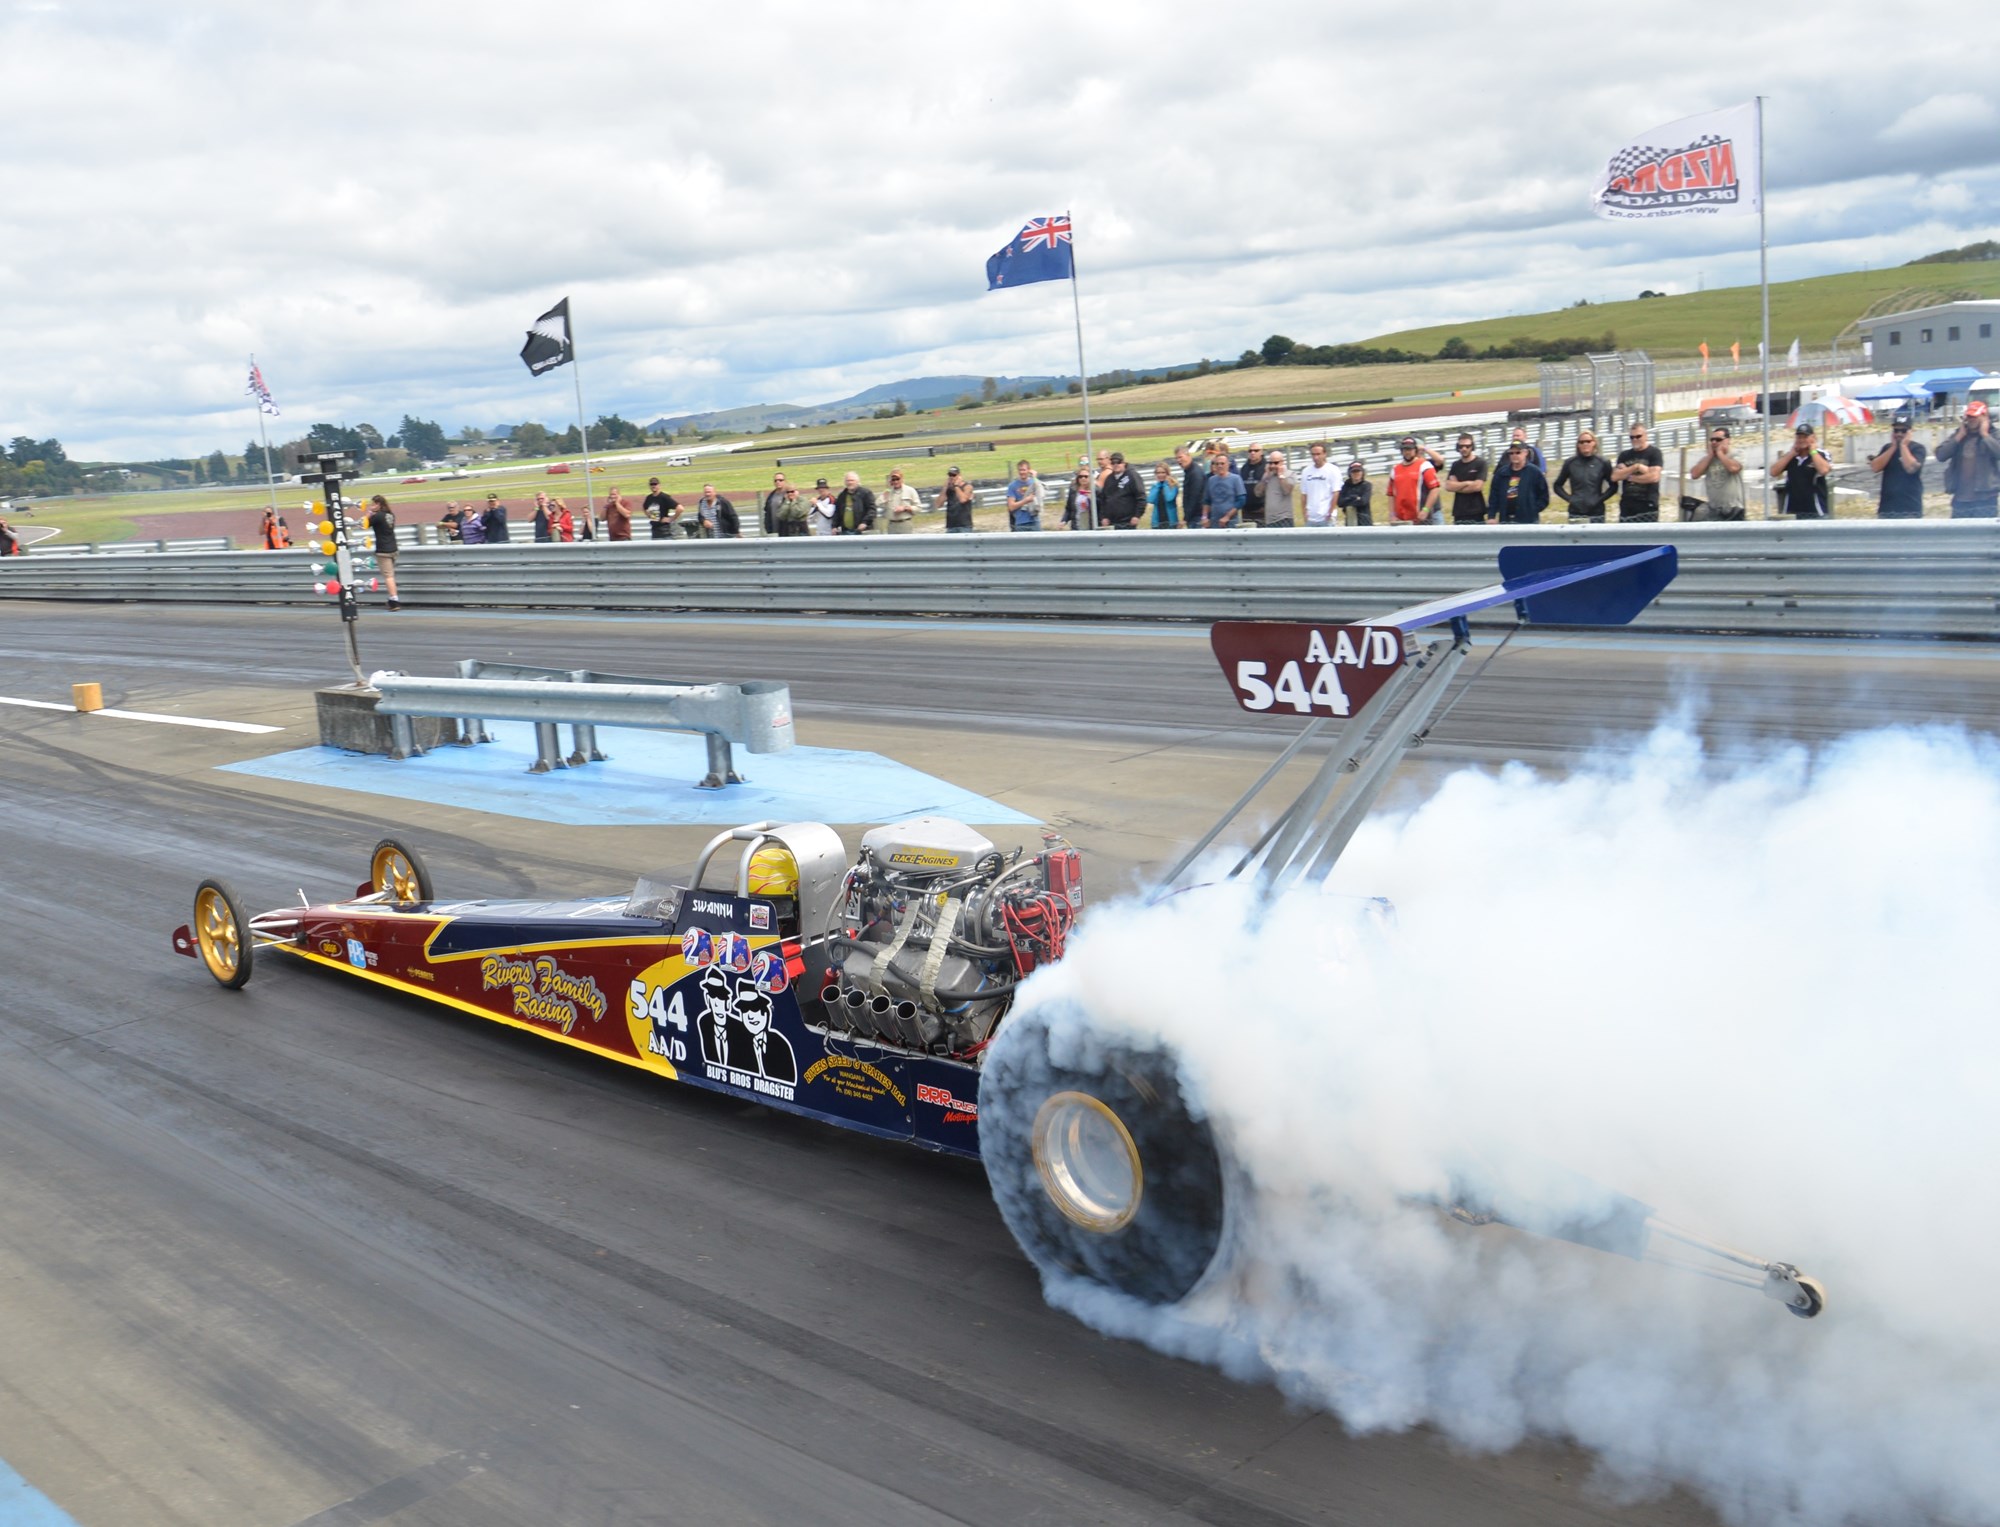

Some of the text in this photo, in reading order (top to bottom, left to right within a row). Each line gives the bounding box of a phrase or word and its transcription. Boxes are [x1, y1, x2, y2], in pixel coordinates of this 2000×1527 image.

[1304, 626, 1399, 668] AA/D
[1237, 660, 1350, 716] 544
[481, 956, 606, 1021] Rivers Family
[514, 985, 578, 1031] Racing
[630, 980, 688, 1033] 544
[648, 1032, 687, 1062] AA/D
[706, 1064, 795, 1101] BLU'S BROS DRAGSTER
[803, 1058, 829, 1084] RIVERS
[861, 1063, 893, 1090] SPARES
[917, 1083, 978, 1114] RRR TRUST
